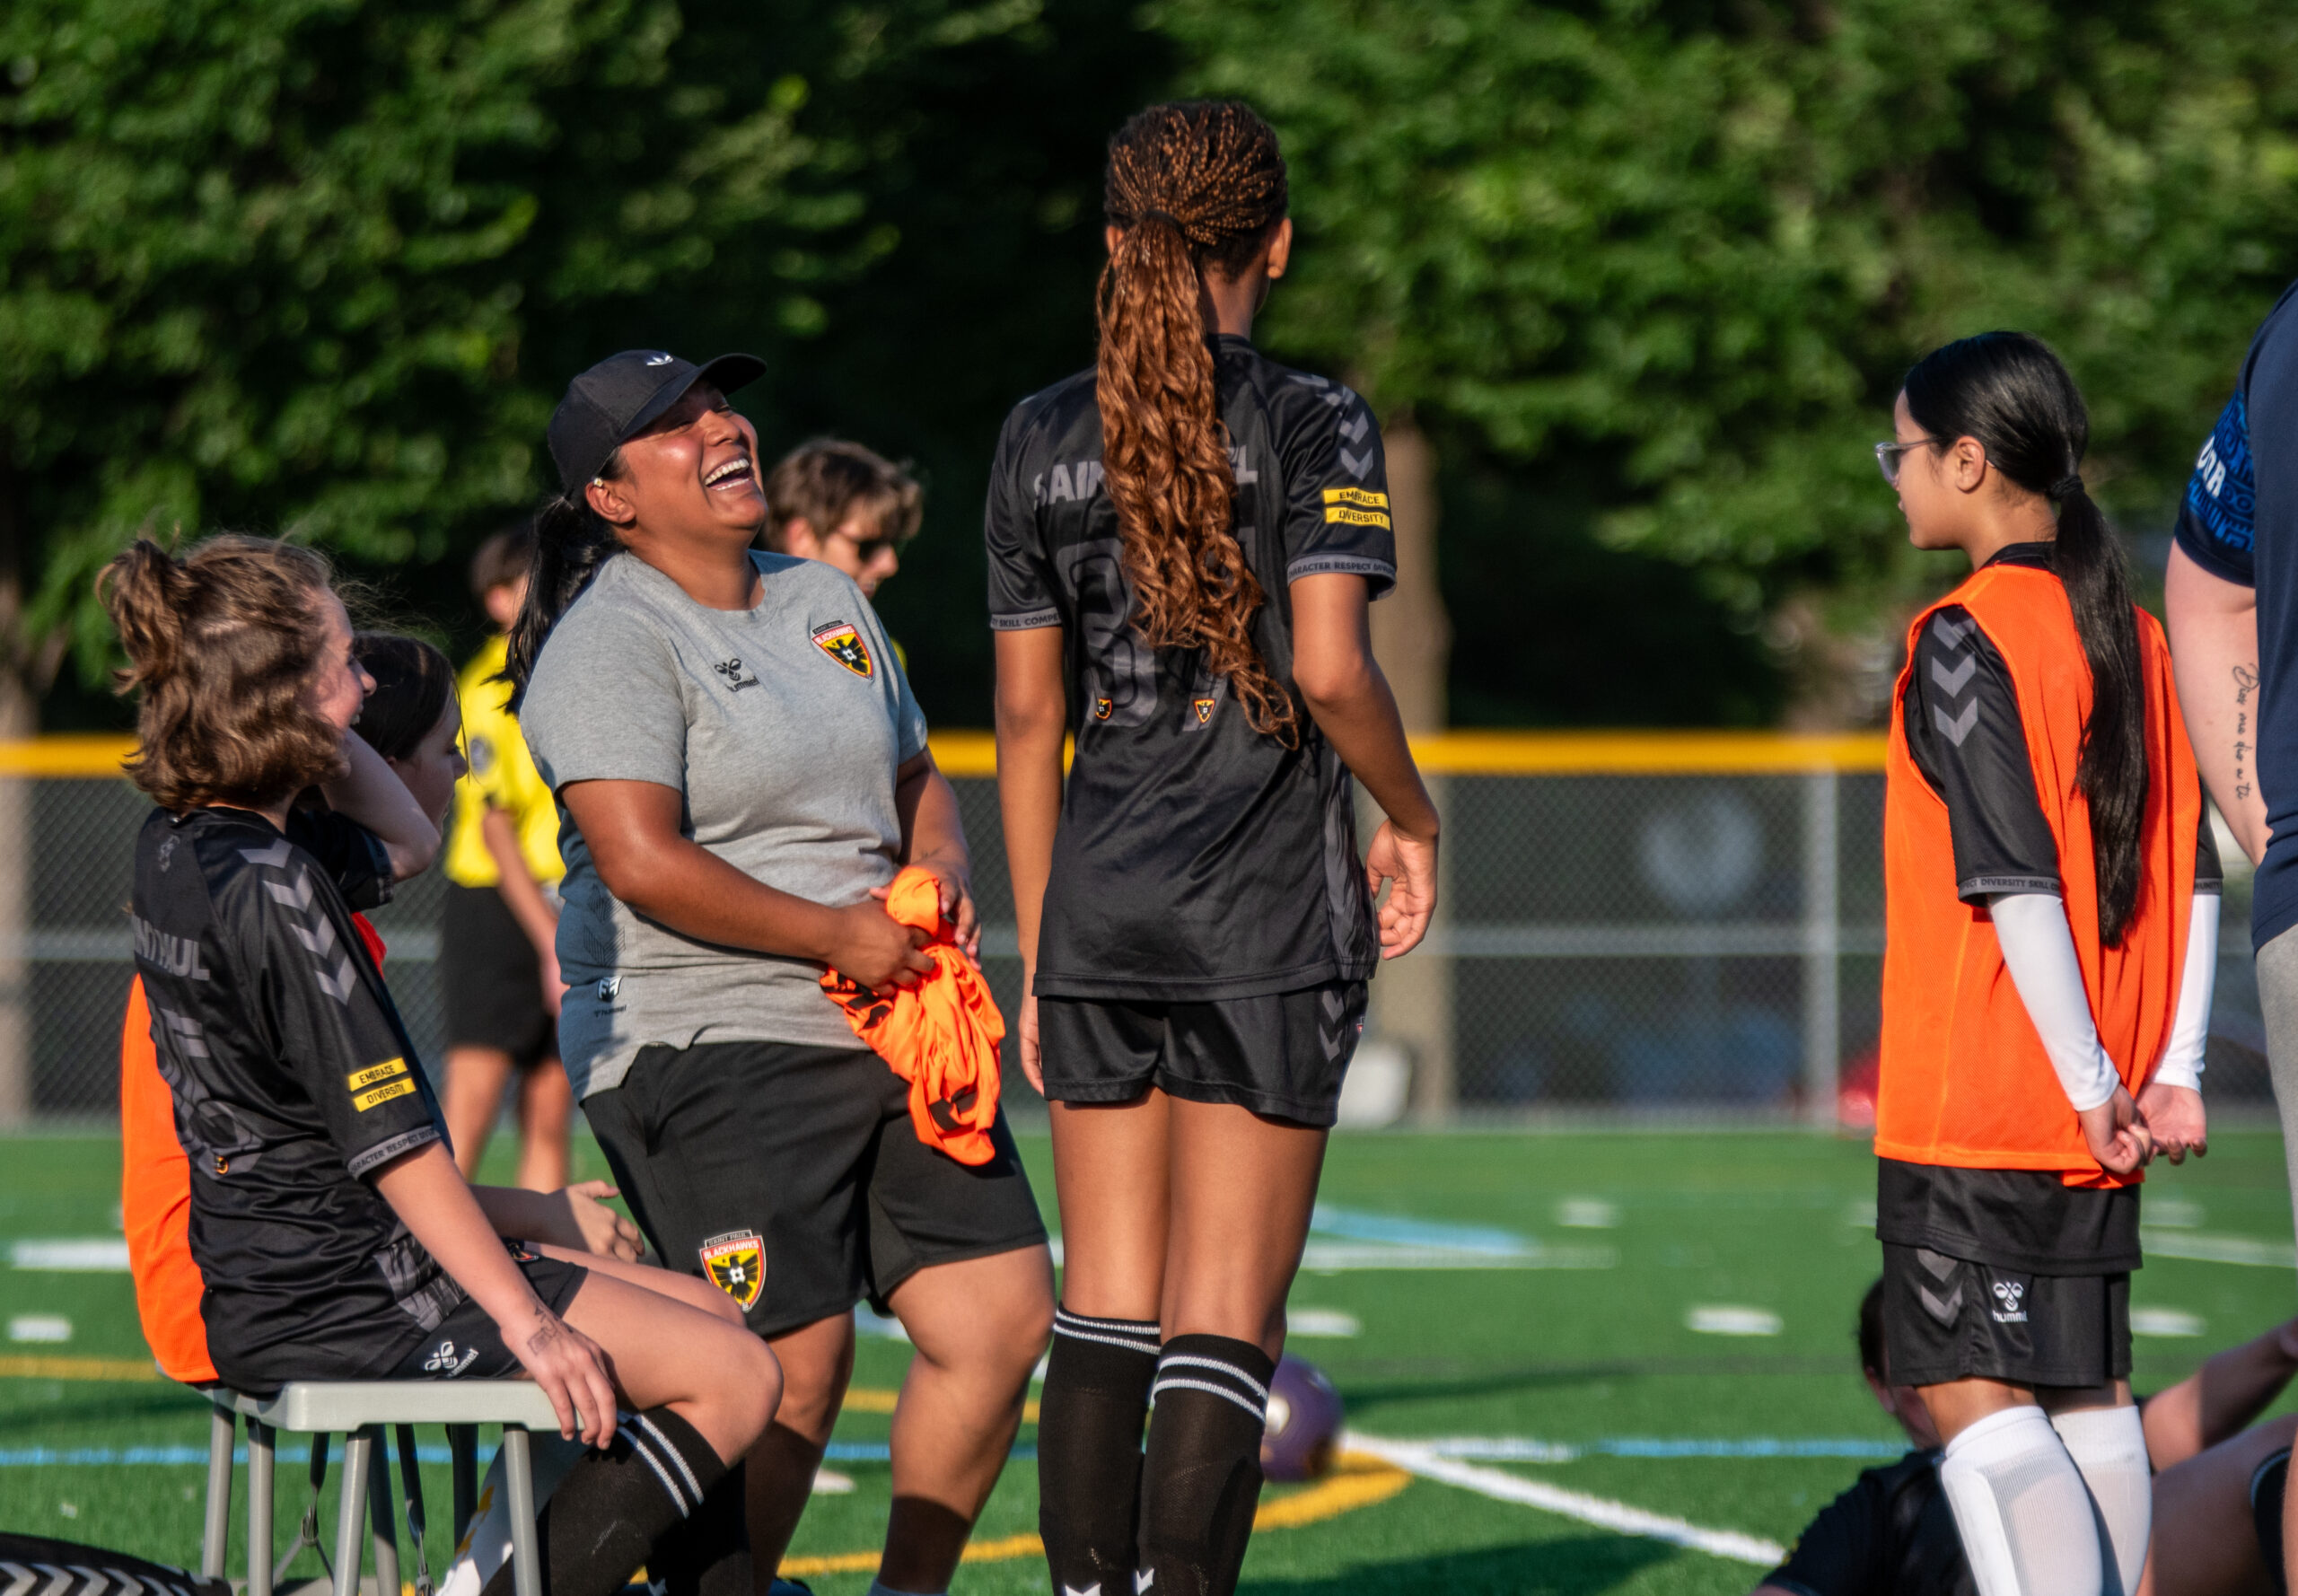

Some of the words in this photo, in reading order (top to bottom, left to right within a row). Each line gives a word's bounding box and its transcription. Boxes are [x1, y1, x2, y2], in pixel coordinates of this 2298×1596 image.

[1338, 491, 1381, 504] EMBRACE
[1338, 510, 1384, 523] DIVERSITY
[1980, 878, 2026, 887] DIVERSITY
[2028, 880, 2049, 890] SKILL
[358, 1065, 396, 1084] EMBRACE
[366, 1083, 406, 1104] DIVERSITY
[704, 1241, 759, 1260] BLACKHAWKS
